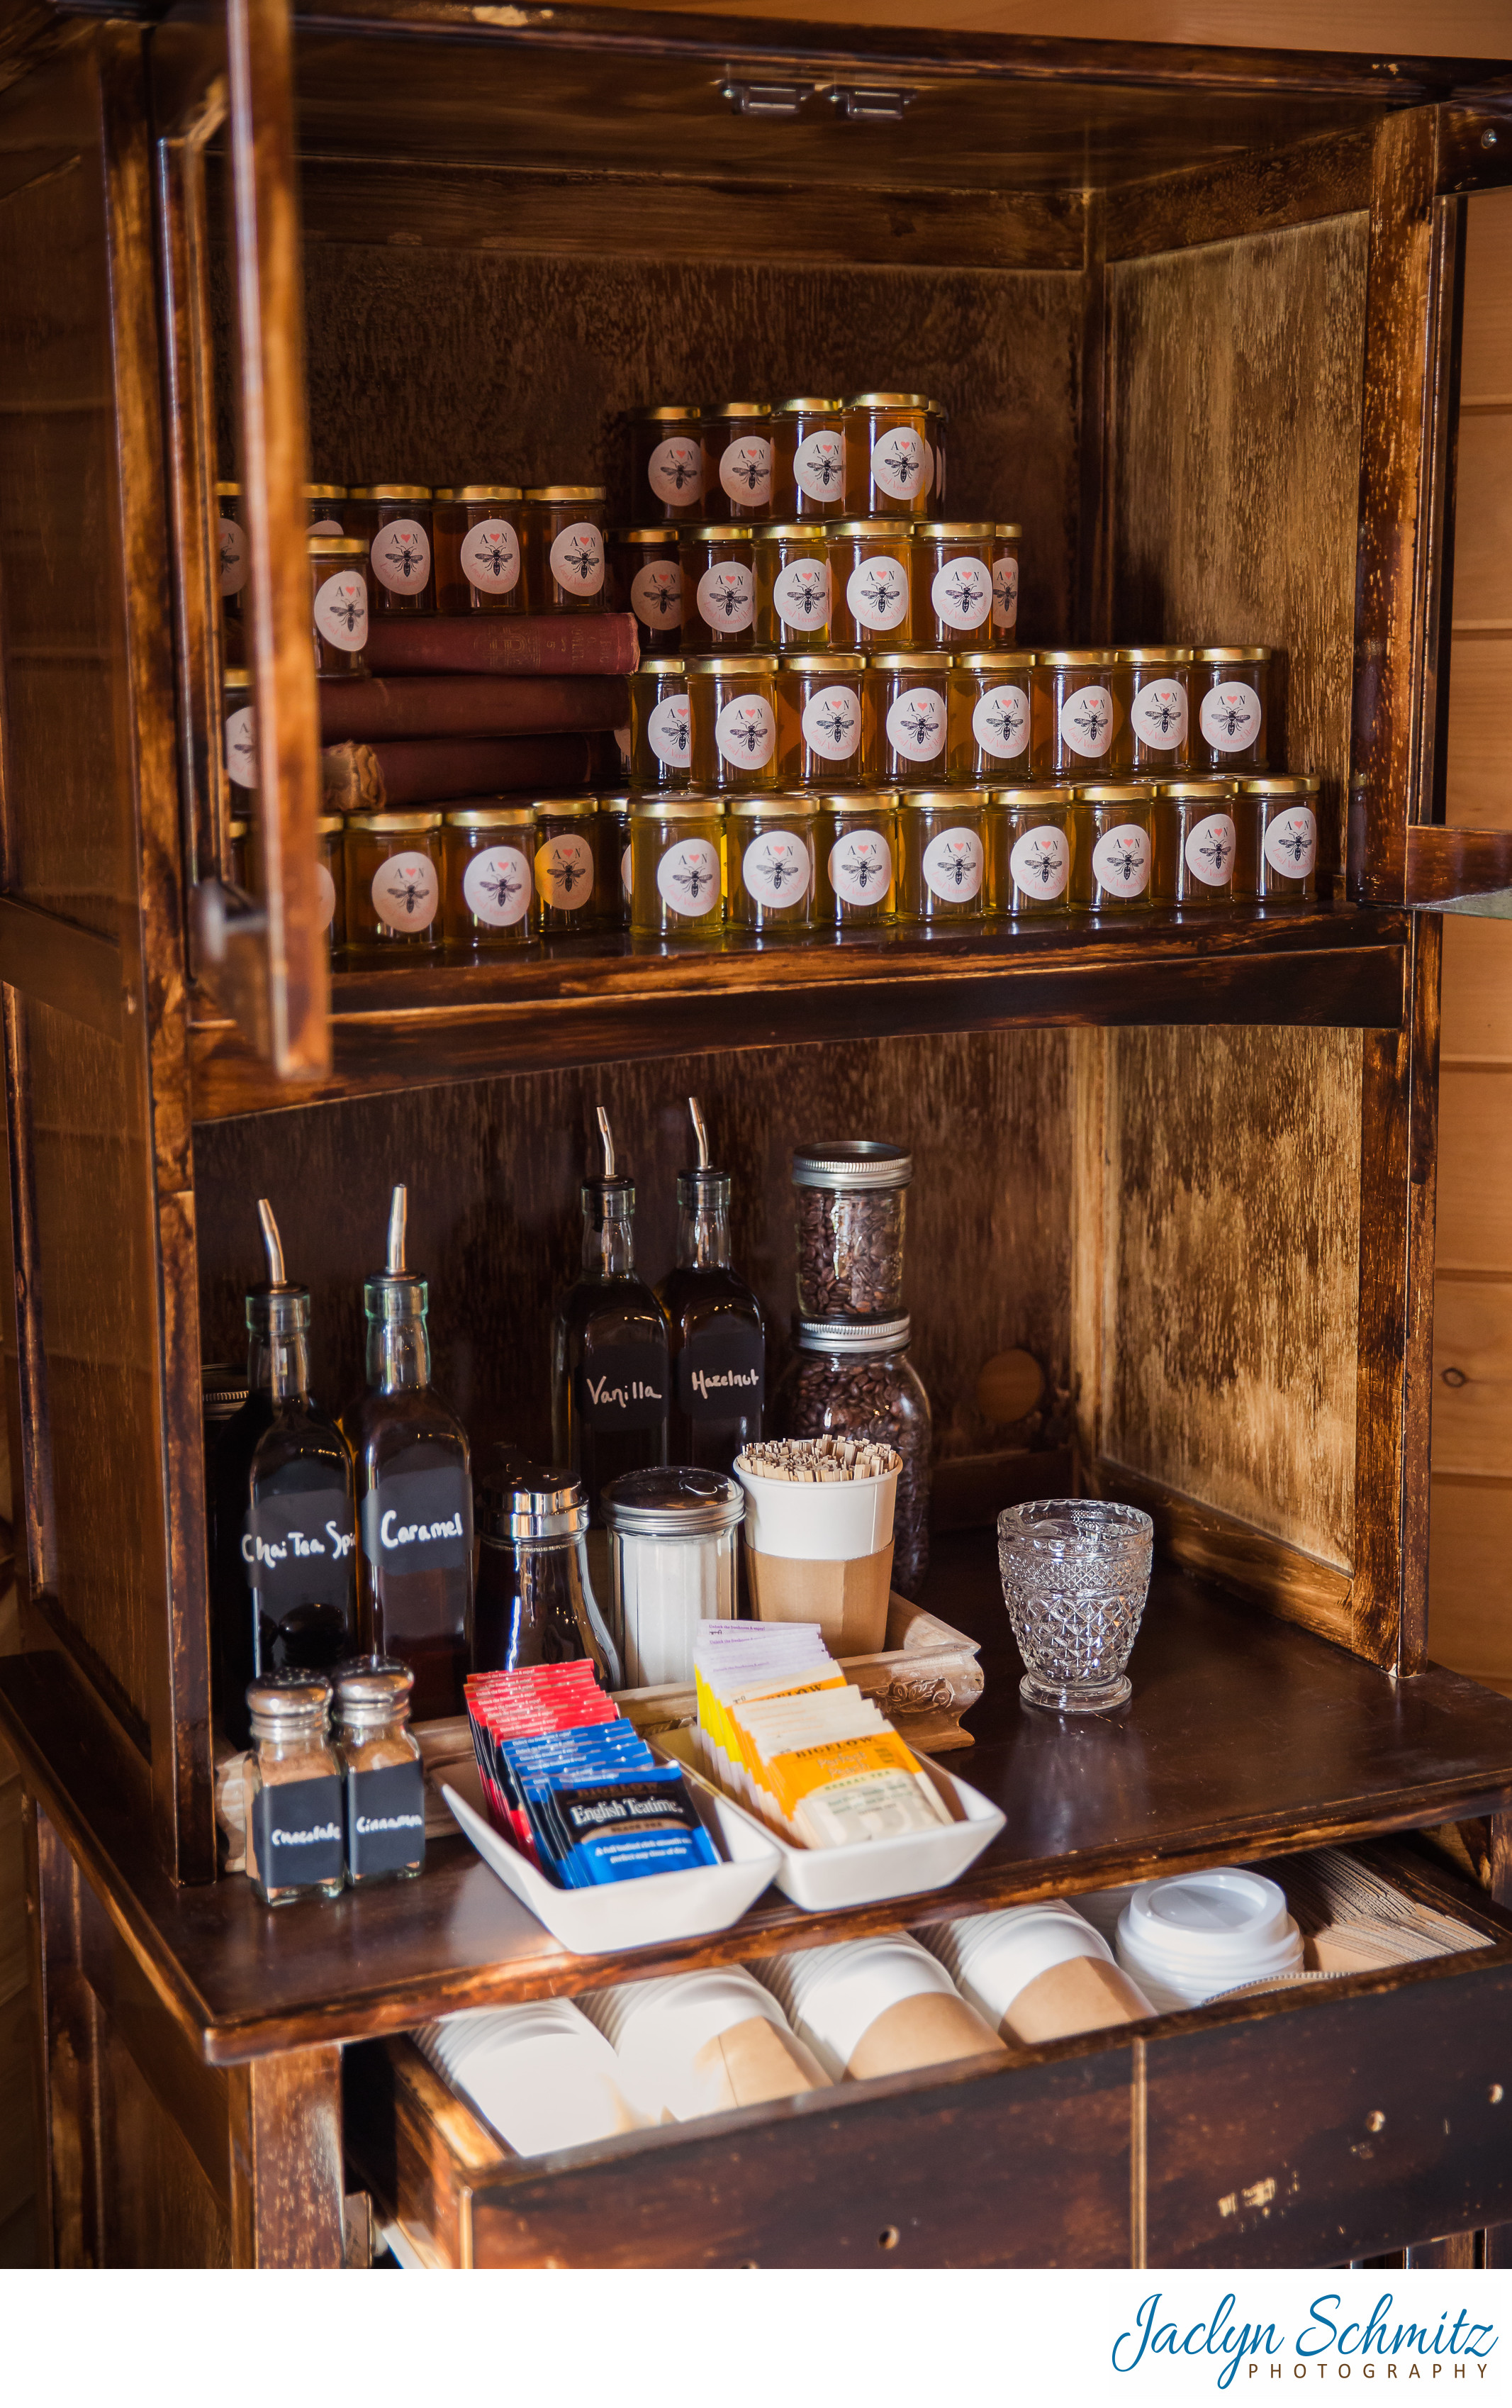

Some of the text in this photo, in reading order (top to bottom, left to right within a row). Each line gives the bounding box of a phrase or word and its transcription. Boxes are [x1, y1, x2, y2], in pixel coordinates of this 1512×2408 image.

[587, 1375, 662, 1408] Vanilla
[691, 1369, 759, 1399] Hazelnut
[381, 1509, 463, 1549] Caramel
[242, 1534, 288, 1568] Chai
[287, 1532, 325, 1556] Tea
[795, 1736, 873, 1758] BIGELOW
[571, 1801, 627, 1824] English
